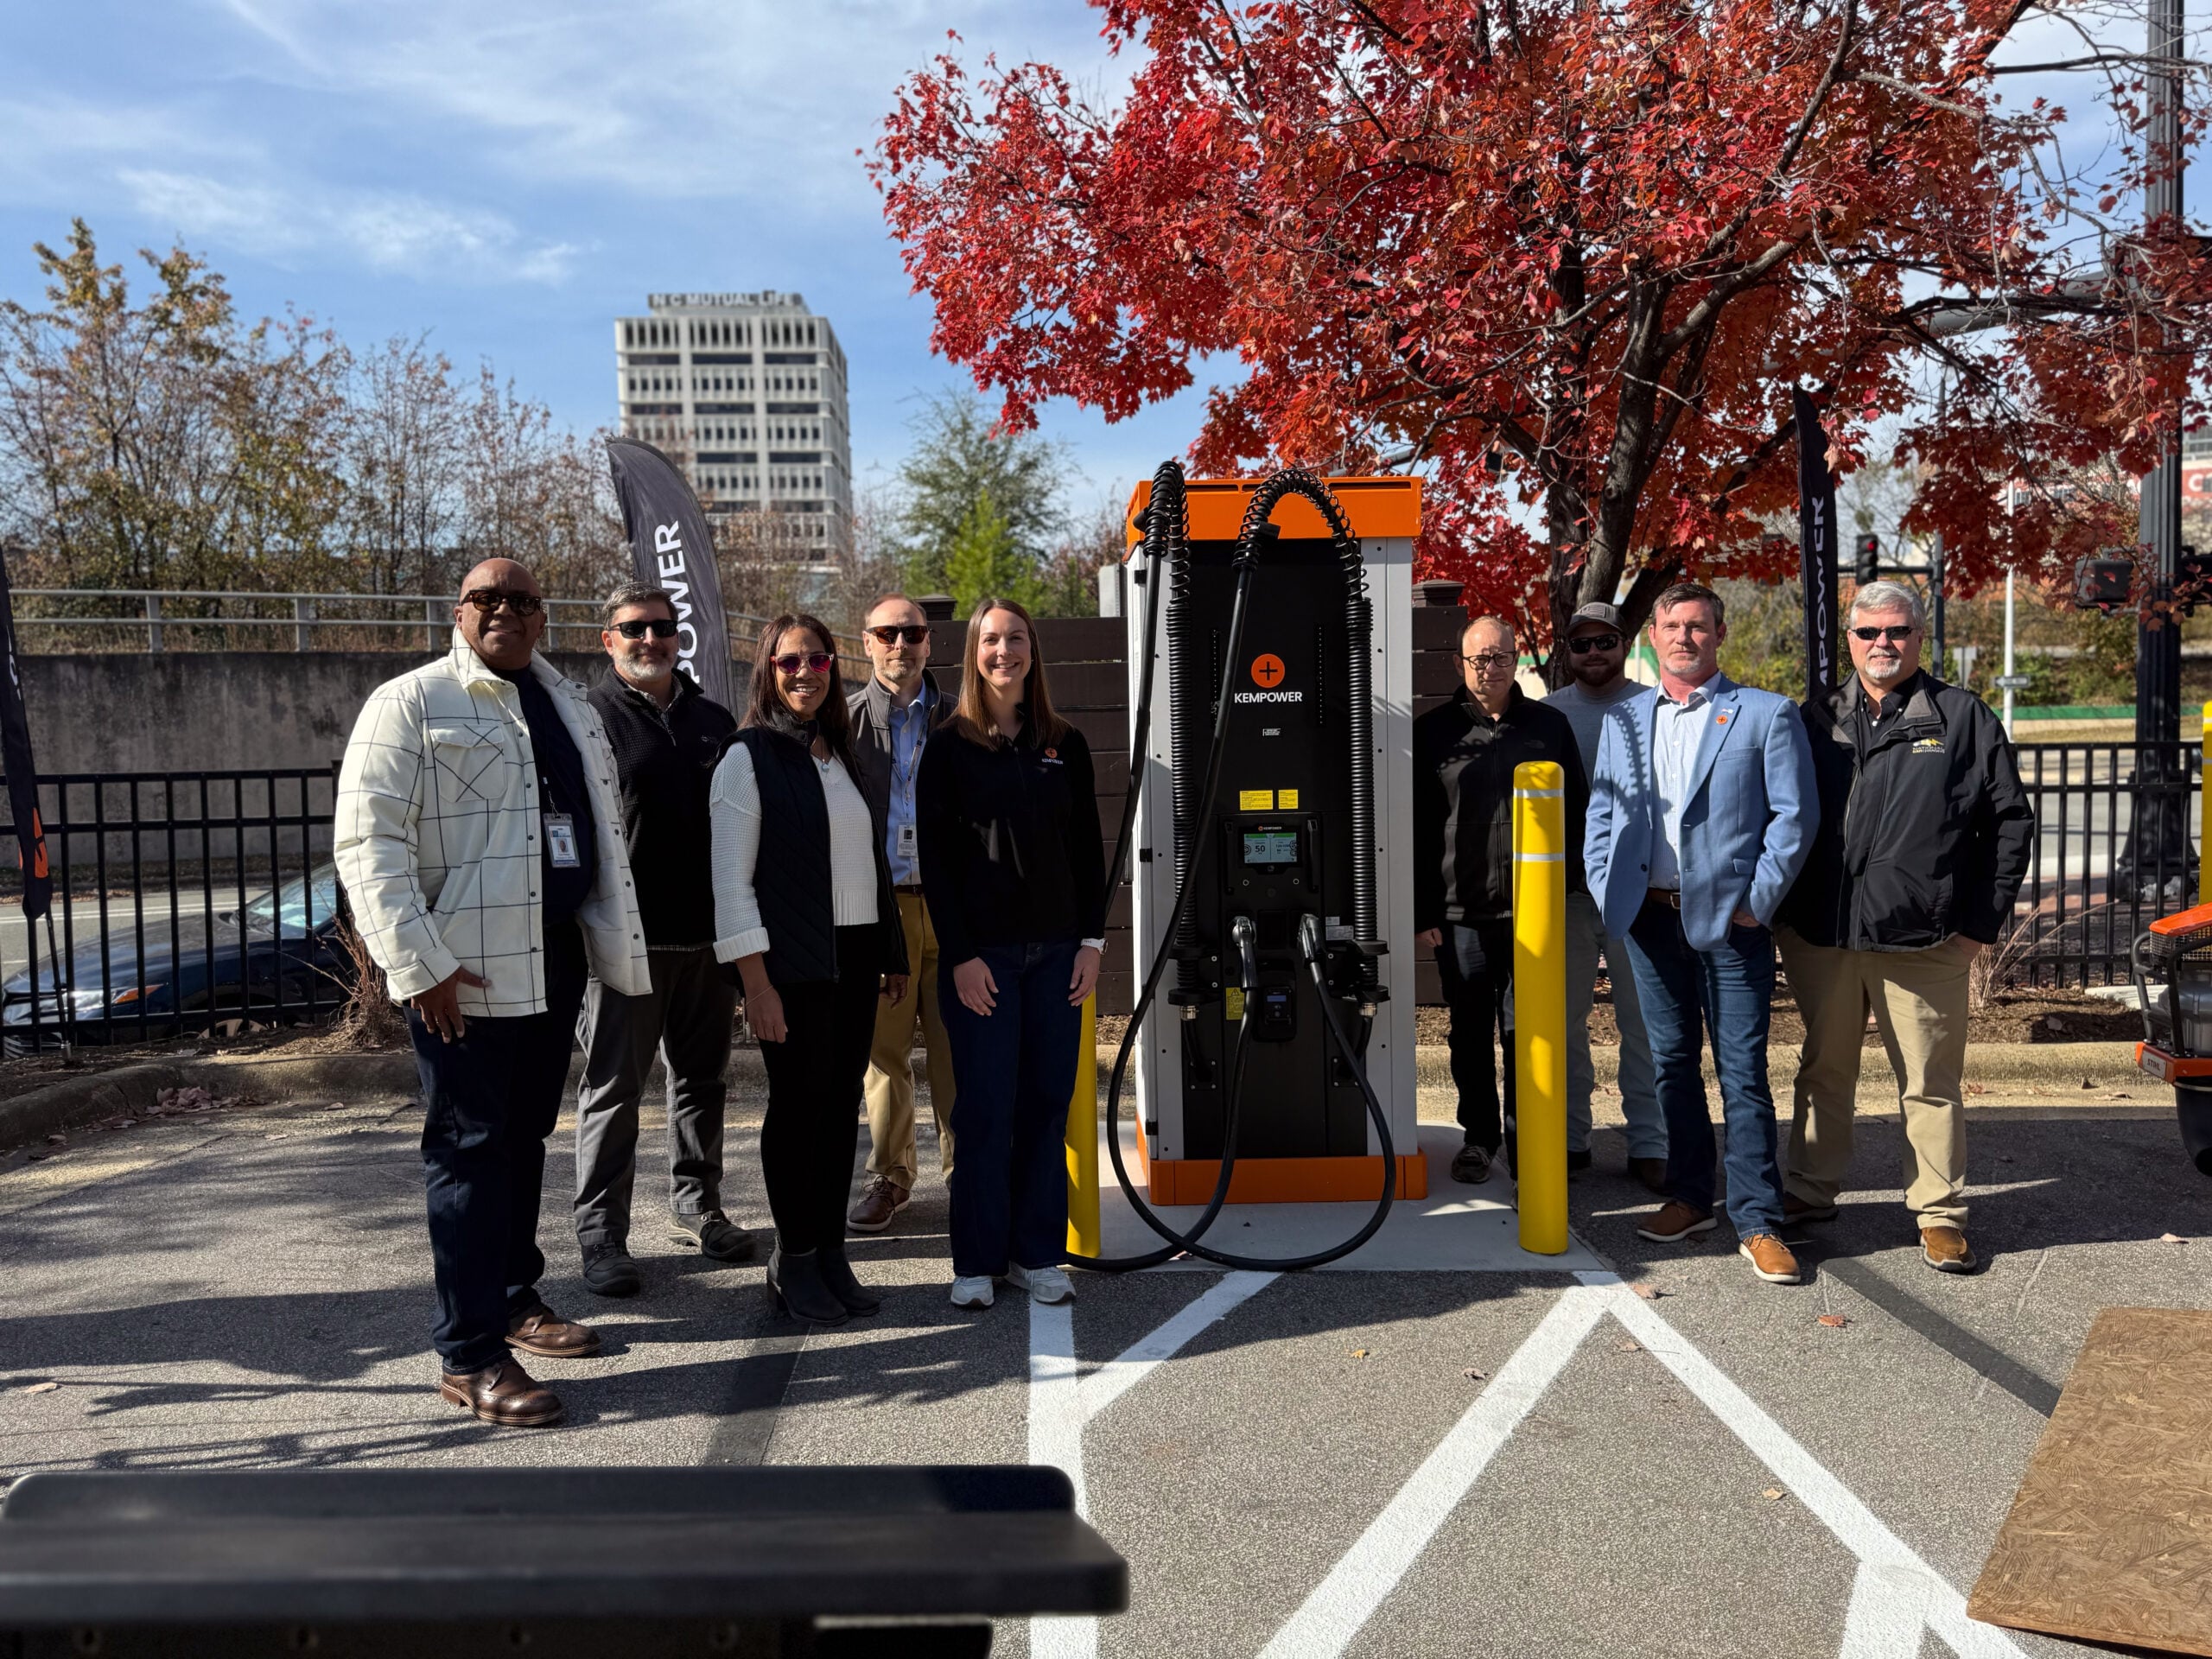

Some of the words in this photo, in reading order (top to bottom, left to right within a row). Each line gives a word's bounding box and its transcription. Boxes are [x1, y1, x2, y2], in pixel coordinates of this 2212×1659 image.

[685, 292, 755, 307] MUTUAL
[759, 292, 793, 307] LIFE
[1234, 691, 1303, 703] KEMPOWER
[1255, 844, 1266, 853] 50
